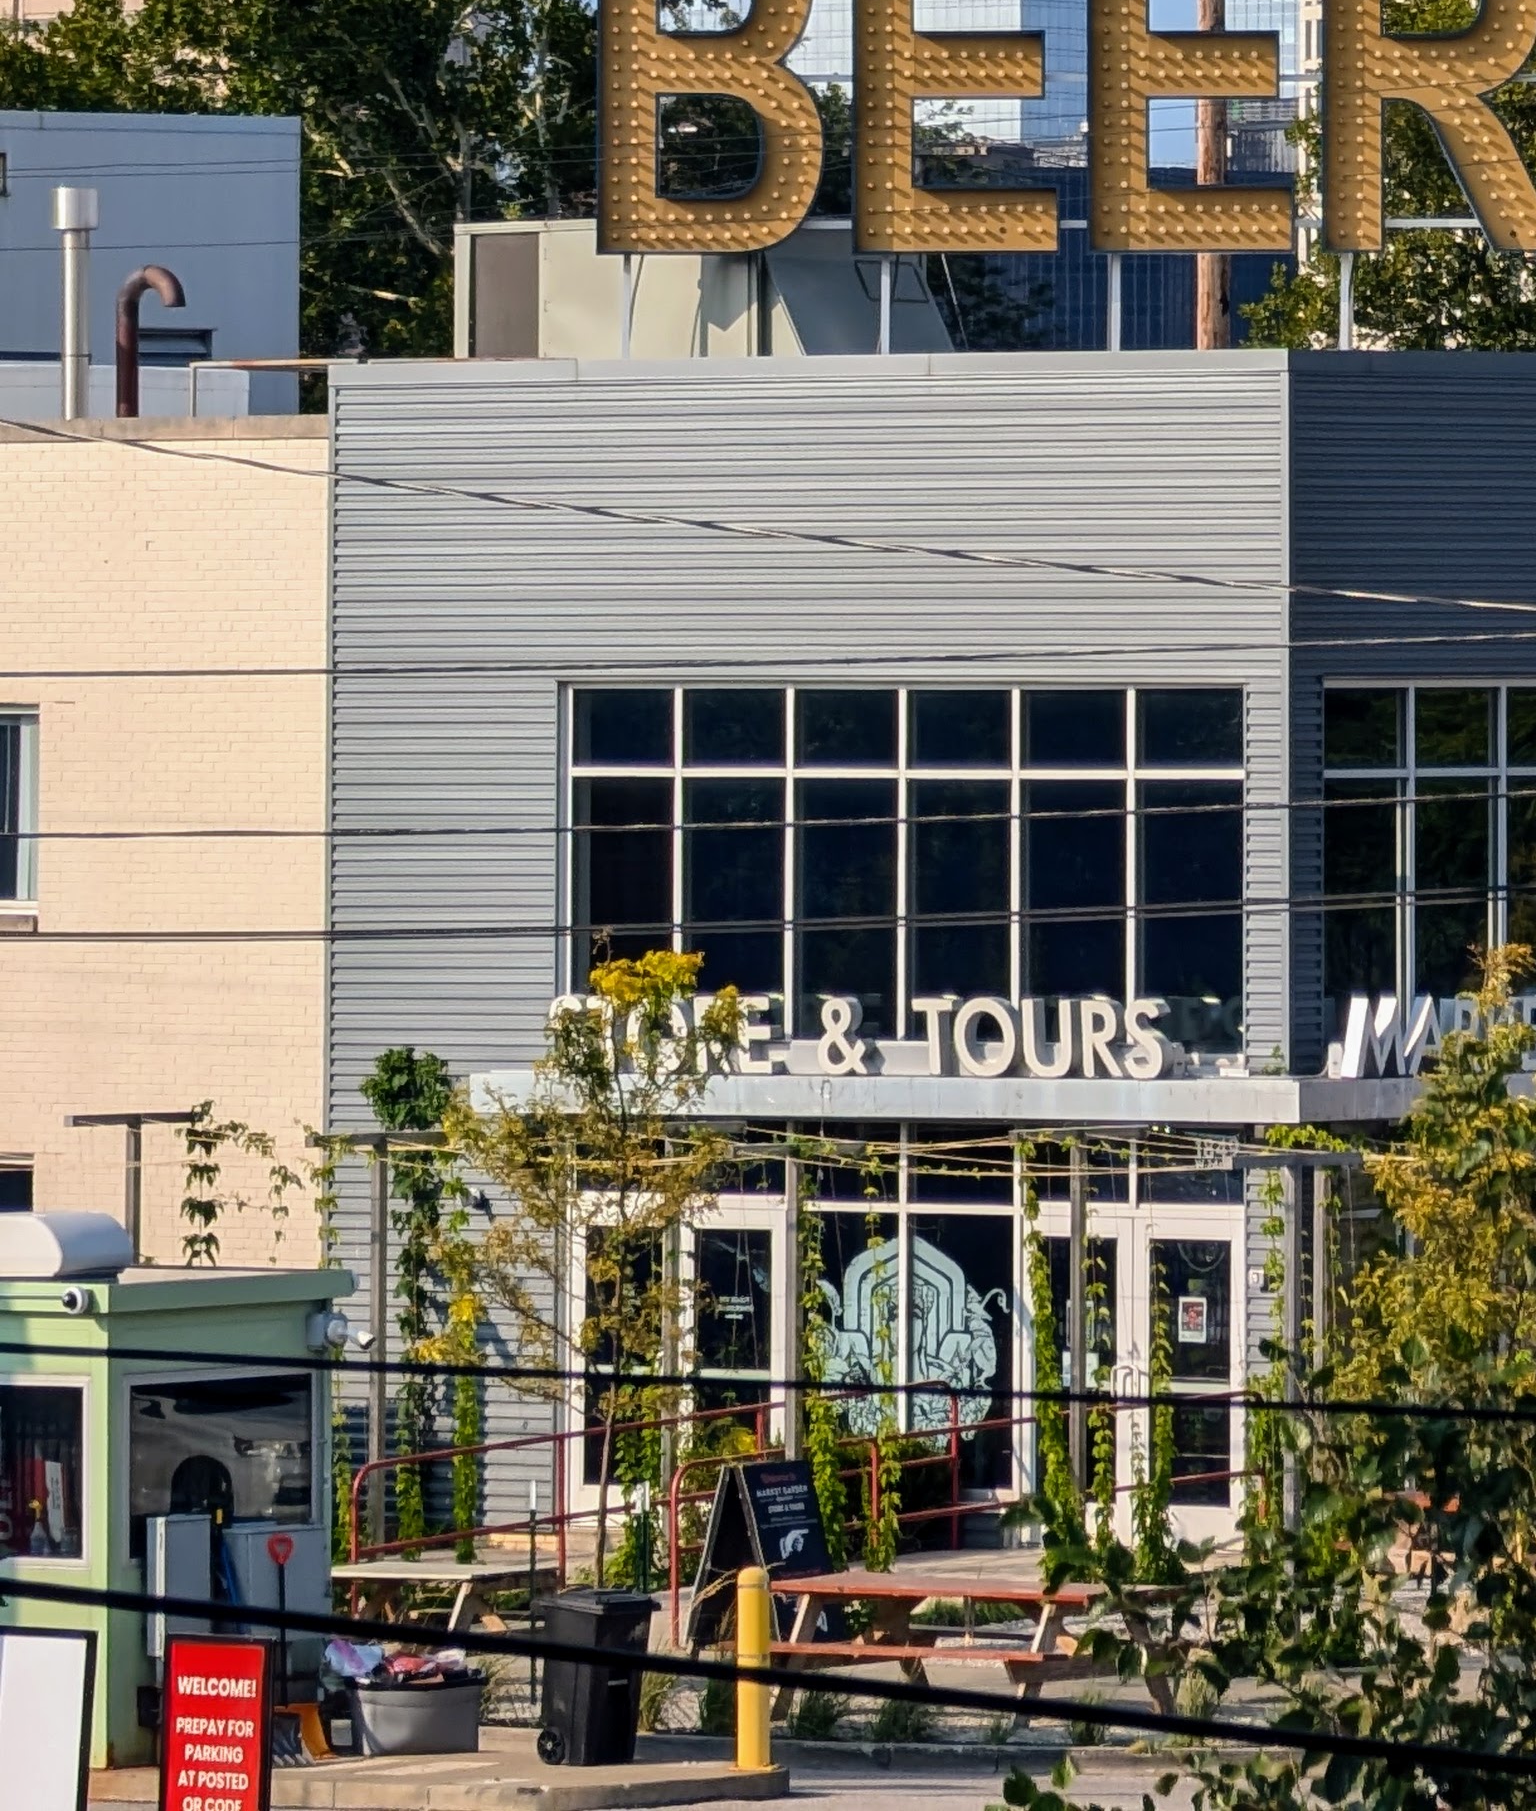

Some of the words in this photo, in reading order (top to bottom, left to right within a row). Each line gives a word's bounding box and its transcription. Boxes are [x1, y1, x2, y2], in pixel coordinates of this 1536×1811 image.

[817, 997, 868, 1075] &
[911, 996, 1167, 1079] TOURS
[177, 1675, 257, 1698] WELCOME!
[176, 1716, 224, 1736] PREPAY
[227, 1720, 254, 1738] FOR
[184, 1743, 243, 1763] PARKING
[177, 1769, 195, 1787] AT
[197, 1770, 249, 1790] POSTED
[204, 1797, 243, 1811] CODE
